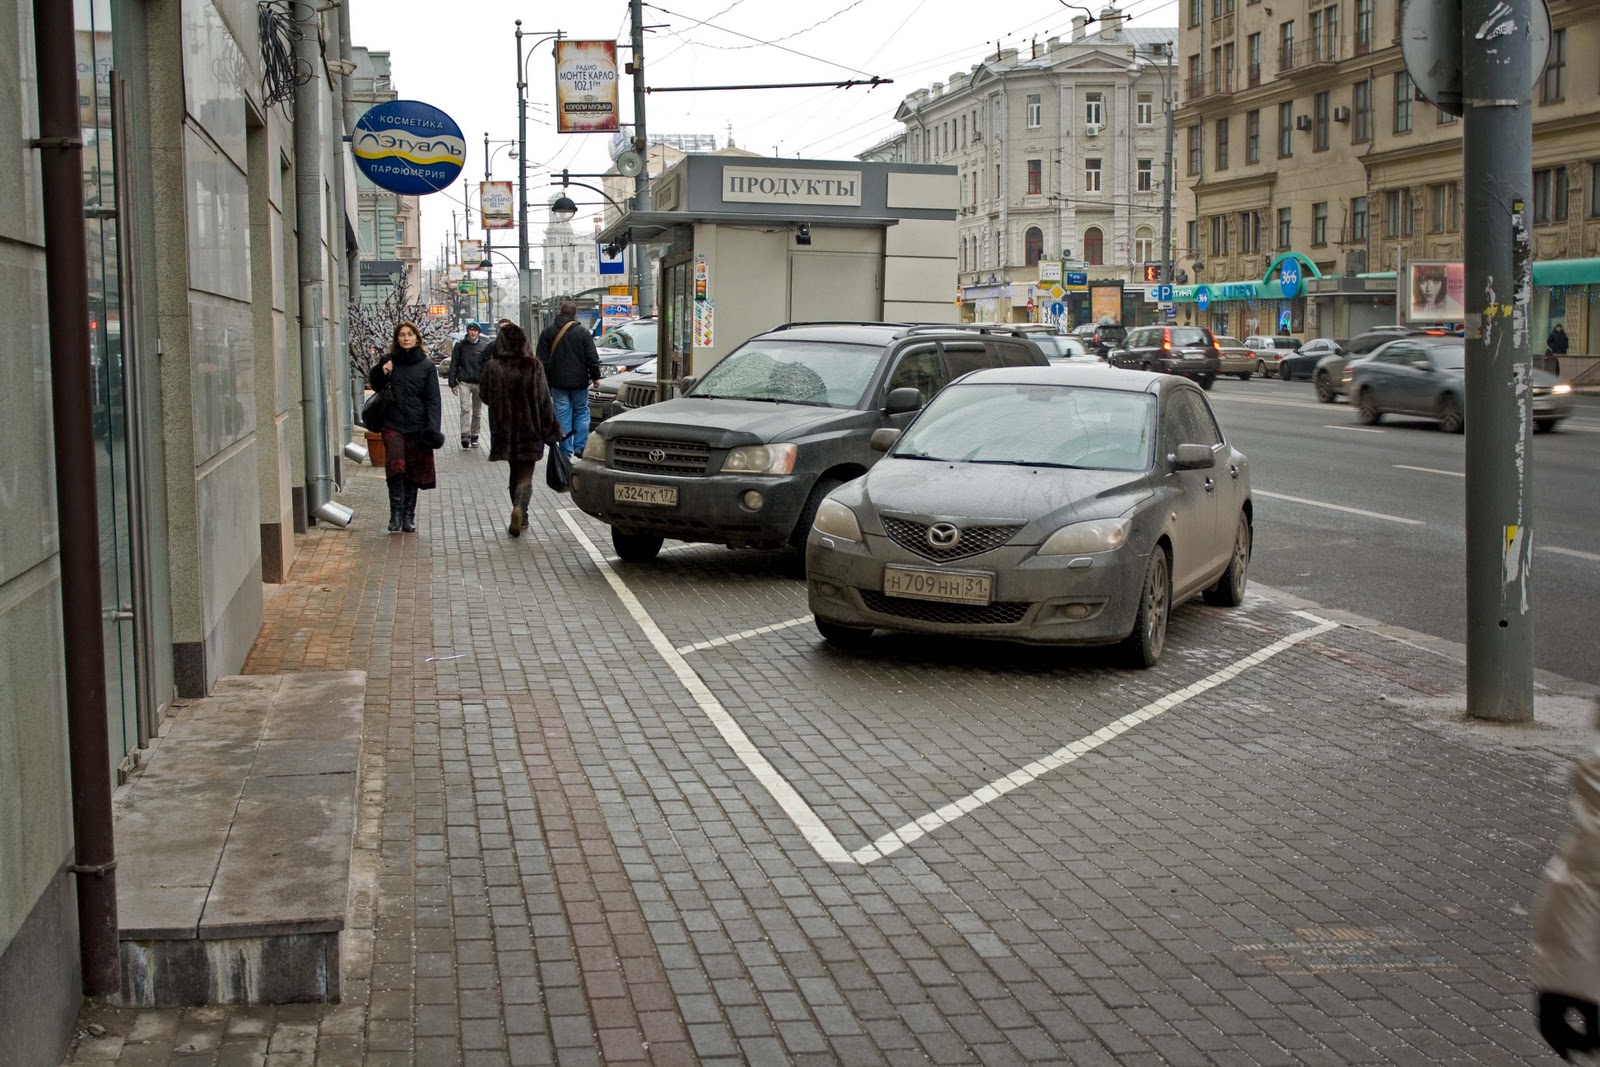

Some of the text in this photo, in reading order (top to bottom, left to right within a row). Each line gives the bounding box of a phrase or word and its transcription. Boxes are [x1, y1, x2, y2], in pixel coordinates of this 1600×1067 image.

[560, 71, 614, 81] МОНТЕ КАРЛО
[380, 115, 444, 129] КОСМЕТИКА
[371, 164, 446, 180] ПАРФЮМЕРИЯ
[729, 176, 856, 198] ПРОДУКТЫ
